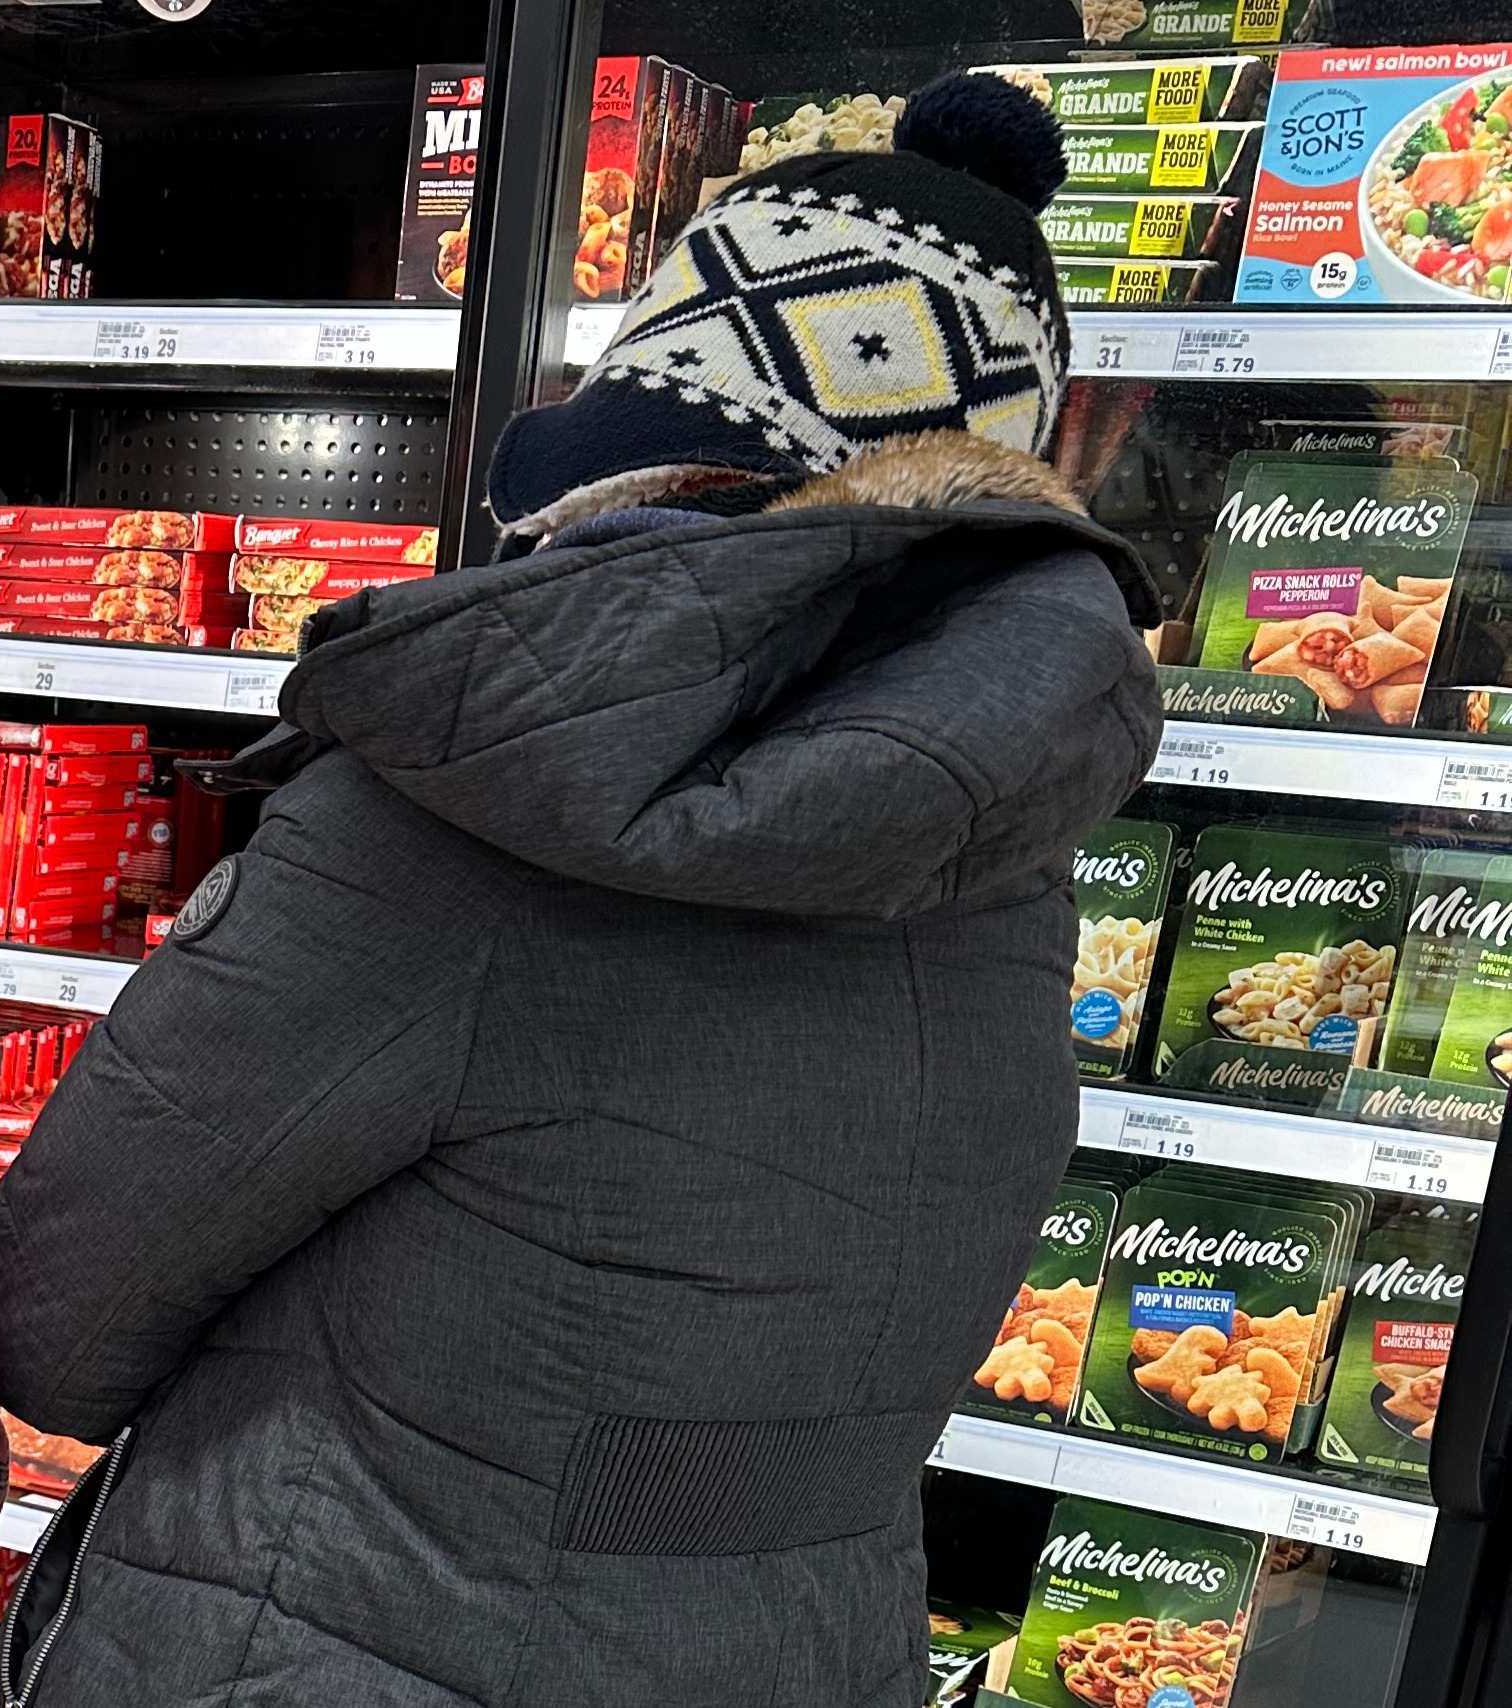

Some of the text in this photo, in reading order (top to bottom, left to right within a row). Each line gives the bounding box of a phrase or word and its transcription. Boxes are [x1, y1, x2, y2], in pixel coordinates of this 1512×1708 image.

[1153, 13, 1234, 34] GRANDE
[1240, 11, 1279, 26] FOOD!
[1322, 49, 1507, 72] new! salmon bowl
[1158, 71, 1202, 88] MORE
[431, 87, 453, 95] USA
[1155, 89, 1199, 106] FOOD!
[592, 101, 632, 112] PROTEIN
[1060, 91, 1147, 117] GRANDE
[1281, 106, 1368, 138] SCOTT
[1163, 133, 1207, 150] MORE
[1159, 152, 1204, 168] FOOD!
[1142, 205, 1185, 221] MORE
[1258, 200, 1354, 213] Honey Sesame
[1138, 222, 1182, 238] FOOD!
[1255, 213, 1344, 232] Salmon
[1042, 221, 1131, 243] GRANDE
[1118, 270, 1161, 287] MORE
[1320, 263, 1348, 280] 15g
[1115, 288, 1158, 302] FOOD!
[120, 345, 150, 359] 3.19
[156, 338, 177, 358] 29
[344, 349, 376, 364] 3.19
[1096, 347, 1122, 369] 31
[1212, 358, 1255, 373] 5.79
[1291, 432, 1377, 452] Michelina's
[31, 522, 51, 532] Sweet
[52, 521, 60, 531] &
[60, 521, 77, 531] Sour
[77, 518, 107, 530] Chicken
[1229, 493, 1446, 548] Michelina's
[245, 525, 302, 546] Banquet
[339, 537, 359, 548] Rice
[360, 538, 368, 547] &
[369, 536, 403, 547] Chicken
[20, 558, 40, 568] Sweet
[40, 558, 48, 568] &
[48, 557, 65, 567] Sour
[65, 556, 94, 567] Chicken
[1252, 574, 1355, 590] PIZZA SNACK ROLLS
[15, 594, 36, 604] Sweet
[37, 594, 44, 603] &
[45, 593, 62, 604] Sour
[63, 592, 91, 603] Chicken
[1279, 589, 1329, 602] PEPPERONI
[35, 673, 54, 690] 29
[1162, 681, 1290, 716] Michelina's
[1190, 767, 1229, 784] 1.19
[1187, 861, 1386, 911] Michelina's
[1195, 914, 1253, 930] Penne with
[1194, 926, 1265, 944] White Chicken
[1419, 954, 1453, 968] White
[1477, 962, 1511, 977] White
[59, 985, 77, 1002] 29
[1208, 1056, 1345, 1091] Michelina's
[1449, 1061, 1479, 1073] Protein
[1361, 1084, 1504, 1125] Michelina's
[1156, 1138, 1195, 1159] 1.19
[1407, 1173, 1449, 1194] 1.19
[1110, 1217, 1310, 1273] Michelina's
[1157, 1267, 1215, 1289] POP'N
[1135, 1291, 1231, 1314] POP'N CHICKEN
[1380, 1336, 1423, 1349] CHICKEN
[1325, 1528, 1365, 1549] 1.19
[1037, 1531, 1226, 1592] Michelina's
[1049, 1574, 1072, 1589] Beef
[1072, 1580, 1080, 1590] &
[1081, 1583, 1120, 1601] Broccoli
